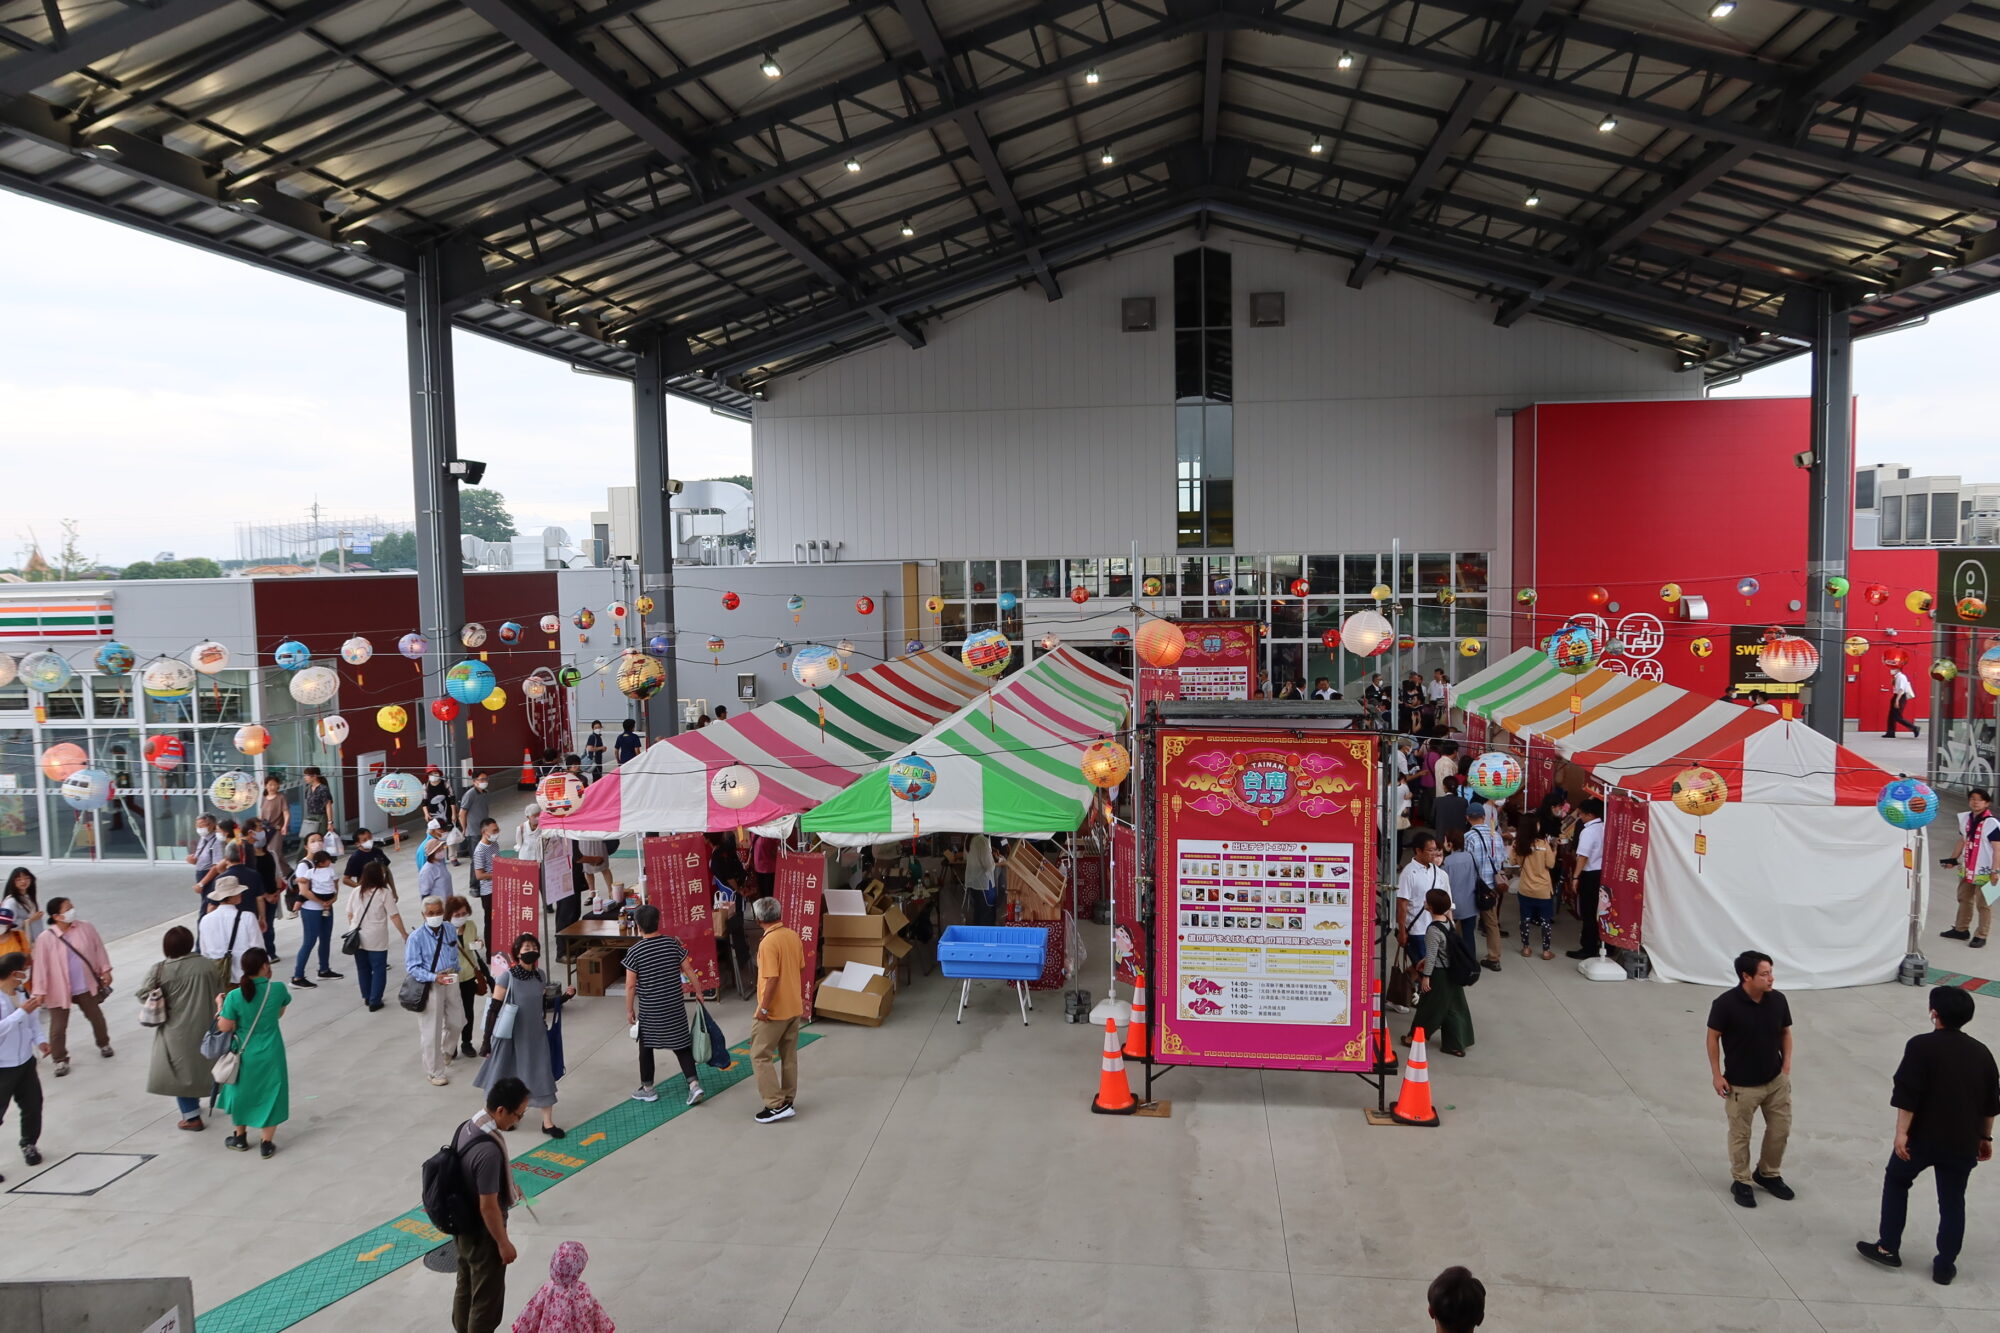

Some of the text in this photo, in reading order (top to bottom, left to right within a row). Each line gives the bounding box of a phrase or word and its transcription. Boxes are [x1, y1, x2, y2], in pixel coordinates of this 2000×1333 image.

[1735, 645, 1766, 656] SWE
[1251, 762, 1284, 770] TAINAN
[1242, 771, 1288, 791] 台南
[1245, 790, 1285, 804] フェア
[1232, 842, 1297, 852] 出店テントエリア
[1625, 818, 1647, 884] 台南祭
[685, 852, 706, 922] 台南祭
[521, 880, 534, 935] 台南
[801, 873, 818, 942] 台南祭
